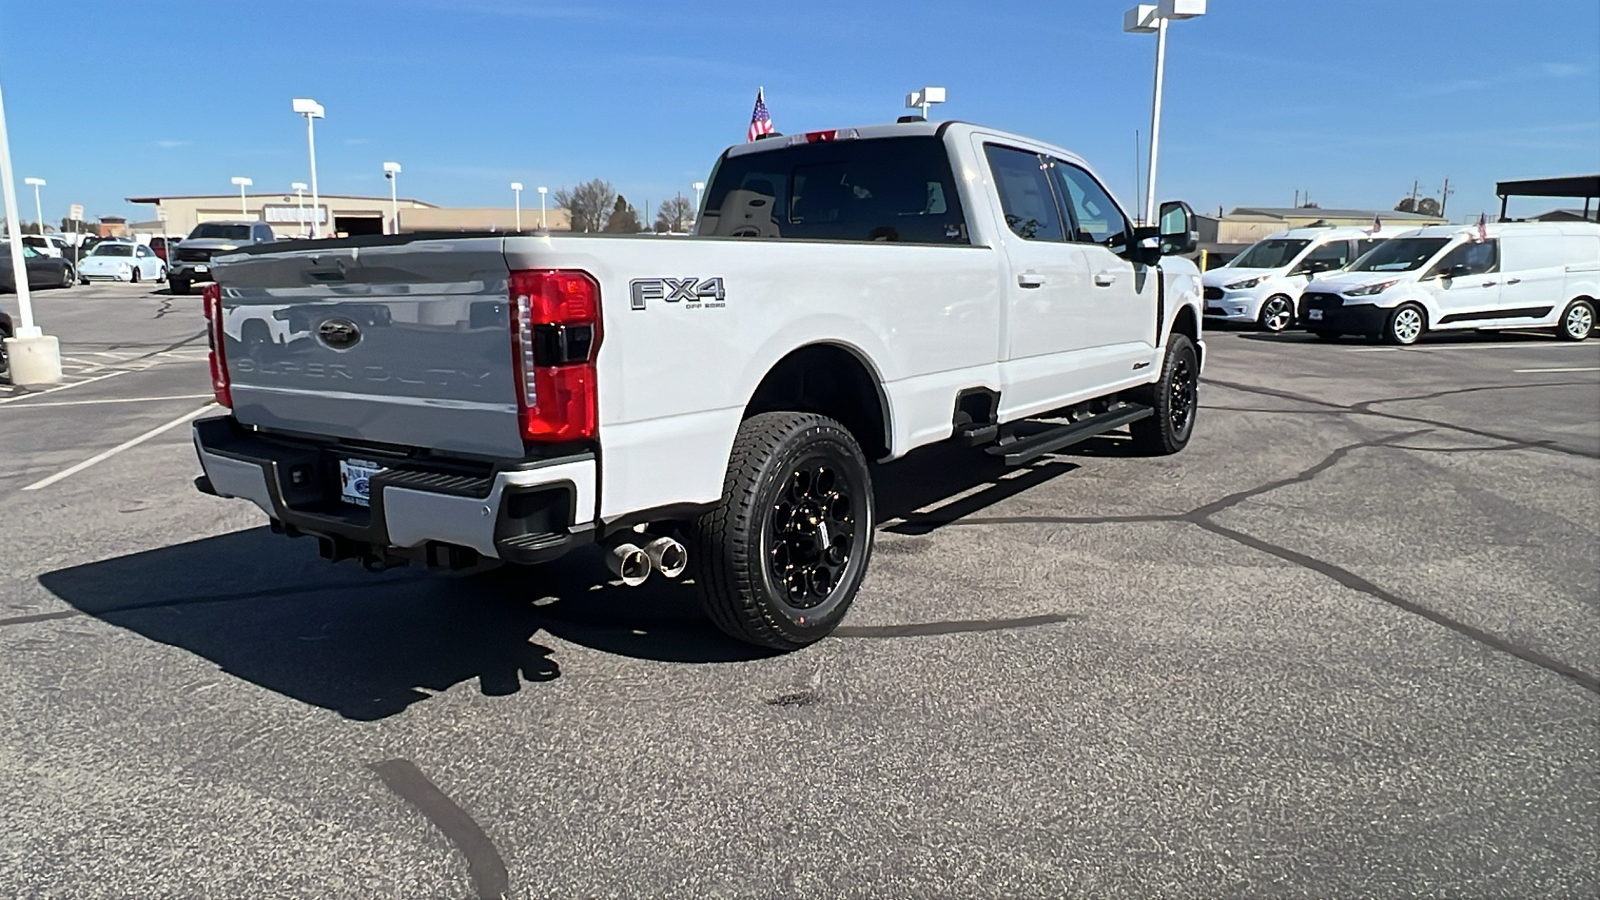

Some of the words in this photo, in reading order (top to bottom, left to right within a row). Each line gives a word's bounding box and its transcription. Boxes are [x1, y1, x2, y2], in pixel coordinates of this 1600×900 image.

[629, 277, 726, 311] FX4
[236, 358, 353, 380] SUPER
[365, 366, 492, 387] DUTY
